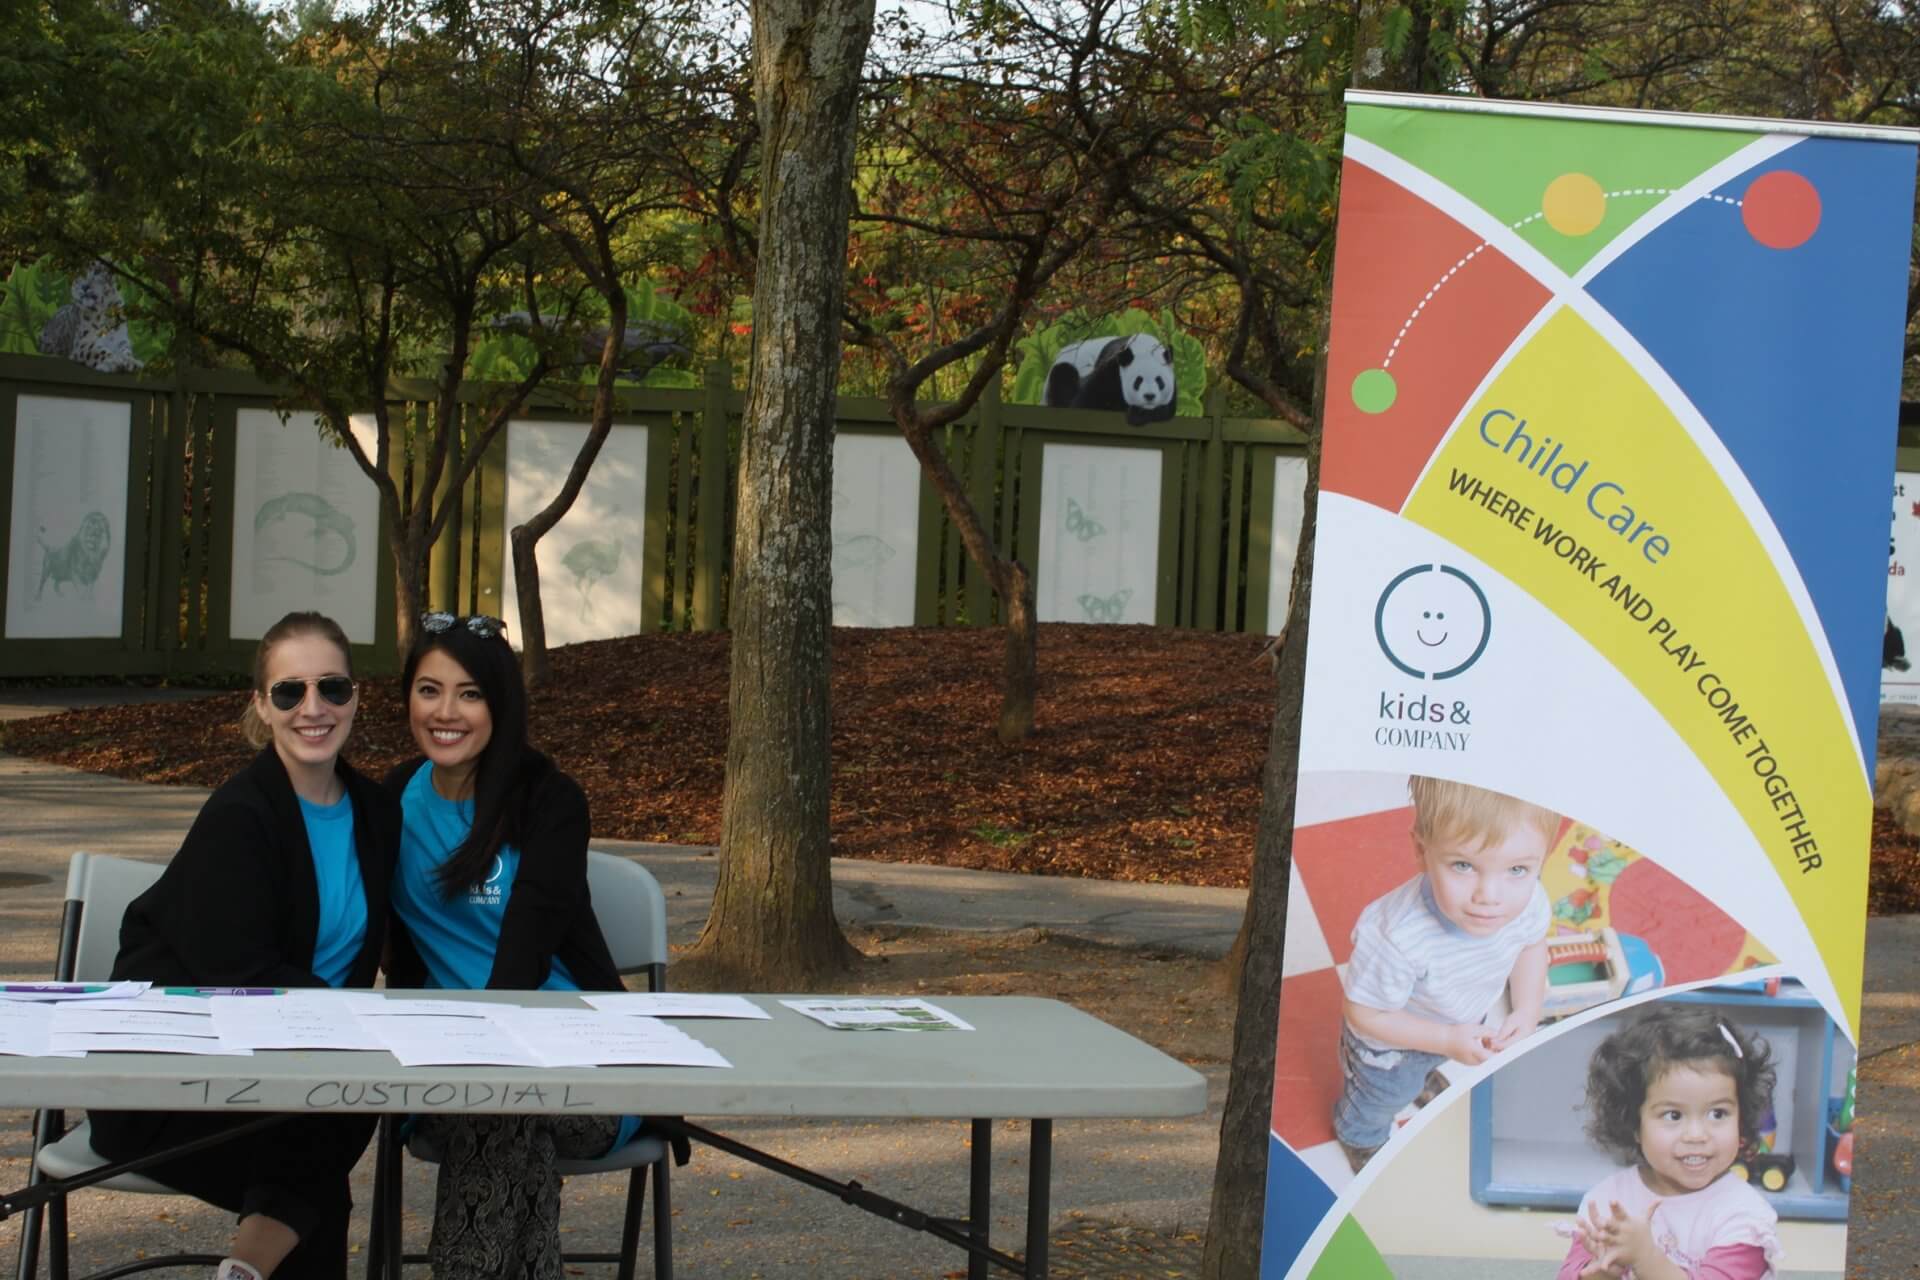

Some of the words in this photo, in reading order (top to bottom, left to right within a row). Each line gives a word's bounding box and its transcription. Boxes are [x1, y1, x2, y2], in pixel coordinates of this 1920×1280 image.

[1479, 409, 1588, 494] Child
[1587, 482, 1670, 564] Care
[1449, 467, 1535, 532] WHERE
[1533, 517, 1607, 583] WORK
[1599, 575, 1654, 623] AND
[1648, 617, 1706, 674] PLAY
[1696, 673, 1758, 746] COME
[1746, 738, 1824, 875] TOGETHER
[1375, 726, 1470, 751] COMPANY
[305, 1080, 595, 1109] CUSTODIAL
